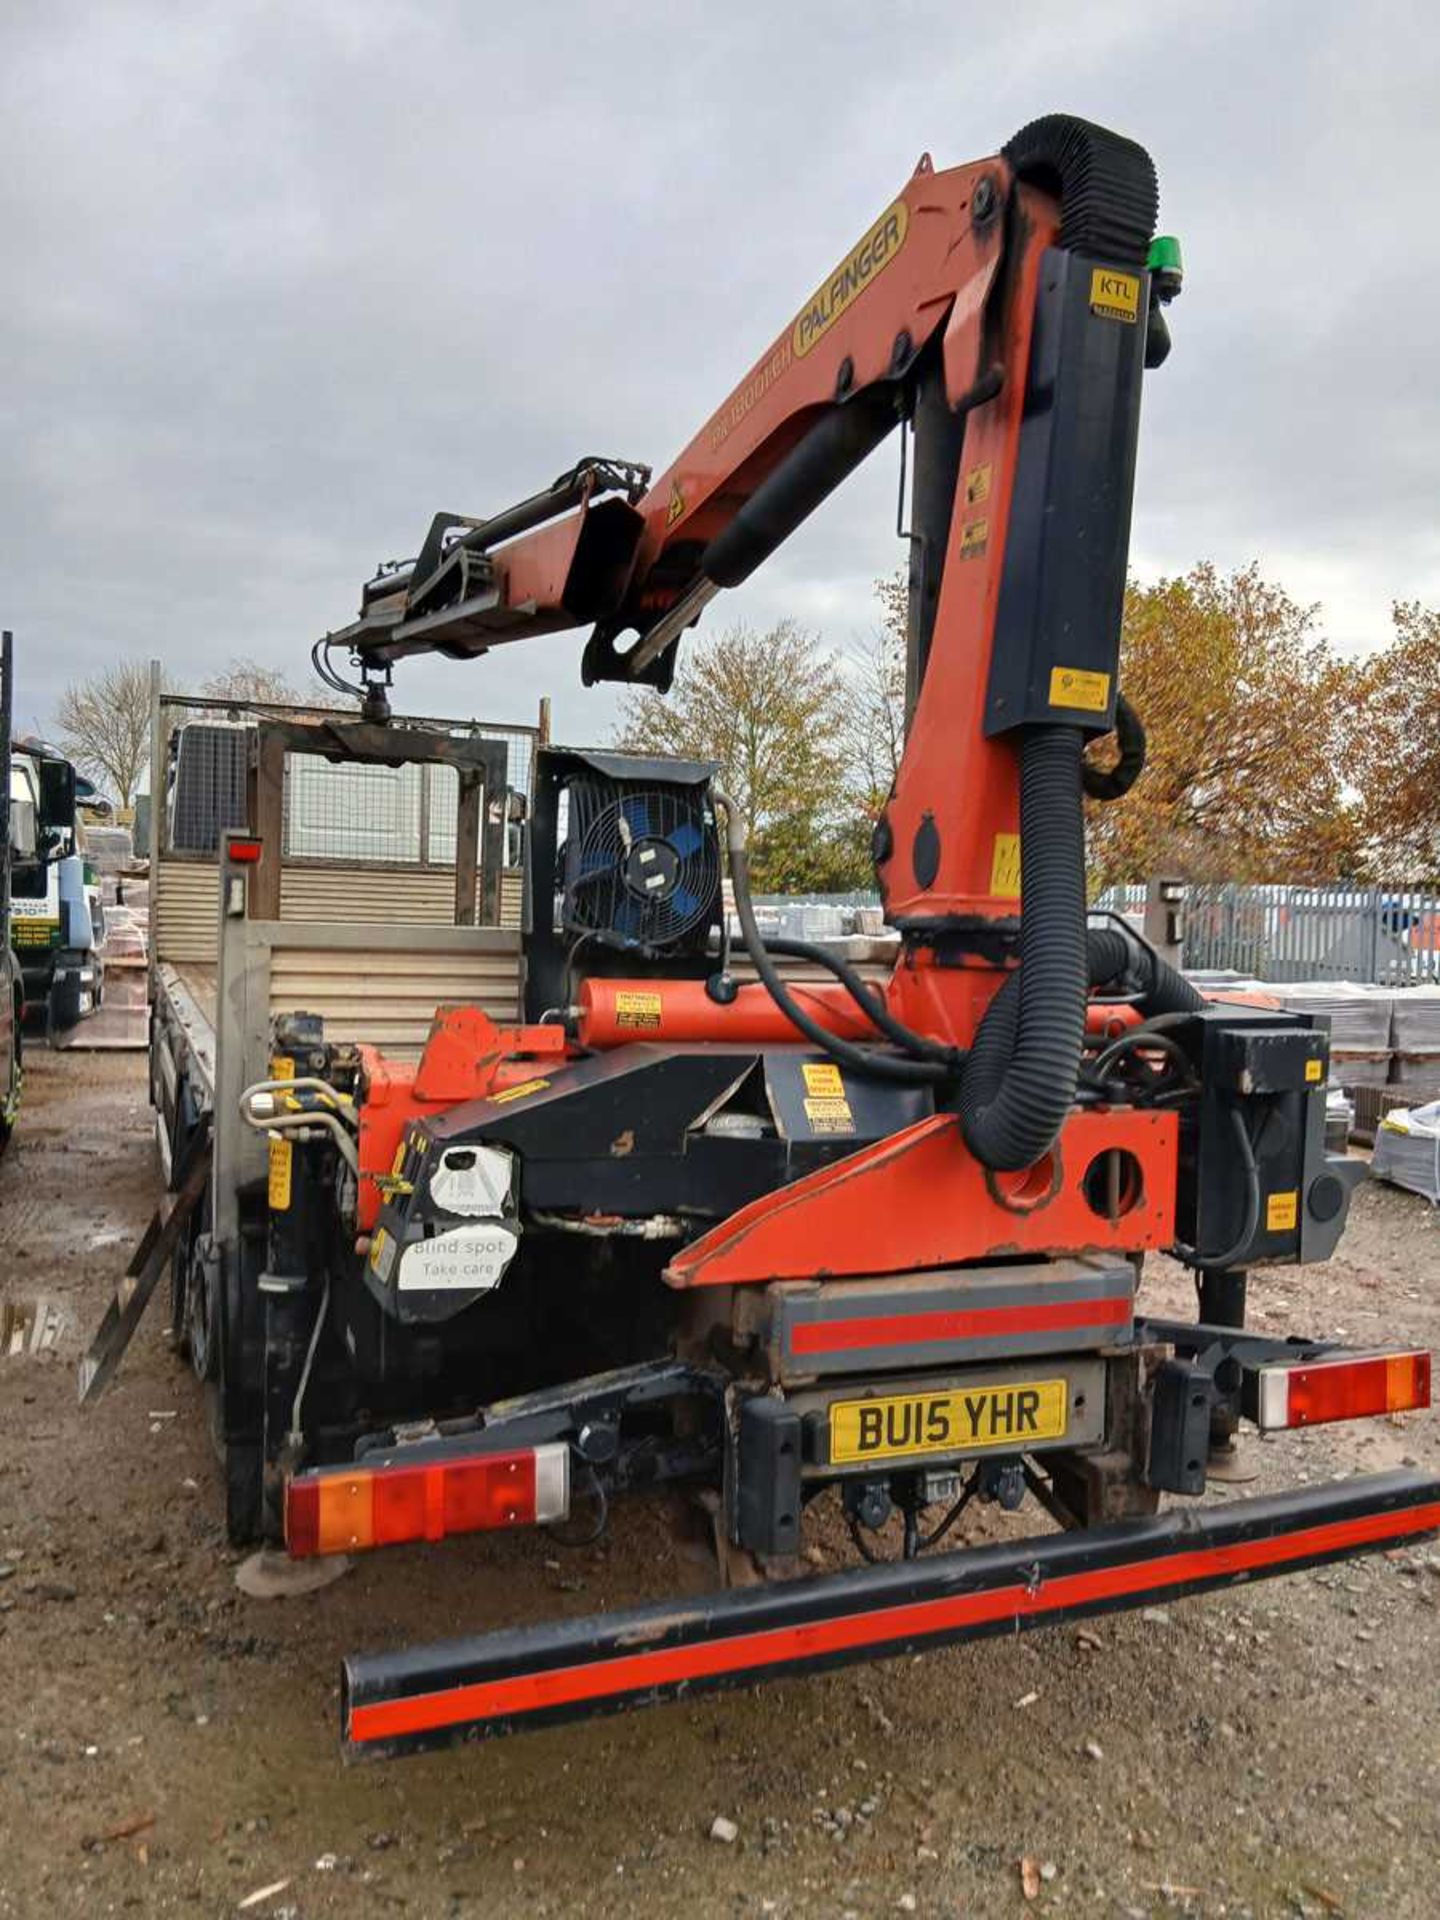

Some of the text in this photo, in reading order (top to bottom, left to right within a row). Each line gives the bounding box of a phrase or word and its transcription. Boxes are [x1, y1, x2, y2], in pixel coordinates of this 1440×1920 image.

[800, 214, 899, 347] PALFINGER
[1100, 276, 1131, 300] KTL
[415, 1239, 504, 1255] Blind spot
[423, 1262, 494, 1276] Take care
[858, 1391, 1040, 1451] BU15 YHR
